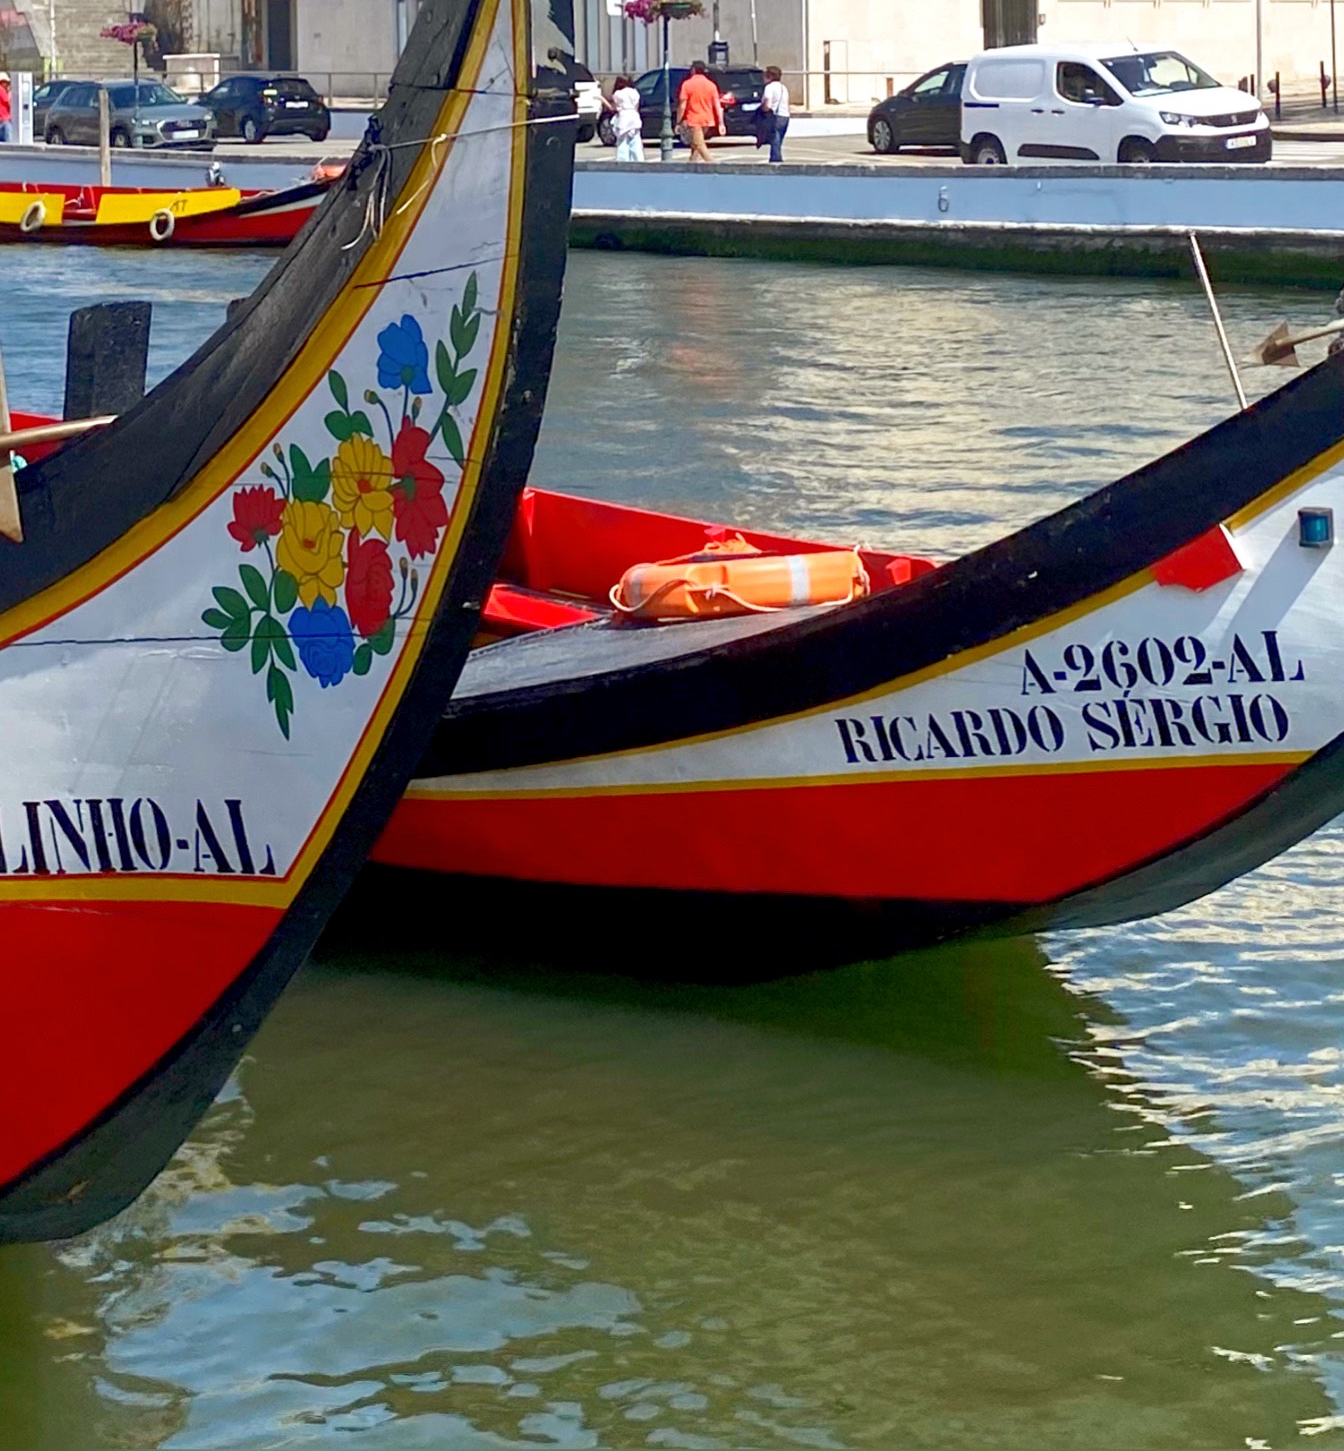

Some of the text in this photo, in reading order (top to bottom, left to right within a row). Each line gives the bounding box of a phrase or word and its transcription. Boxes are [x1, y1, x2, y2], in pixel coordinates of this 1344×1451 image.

[1021, 630, 1305, 696] A-2602-AL
[834, 690, 1290, 764] RICARDO SÉRGIO
